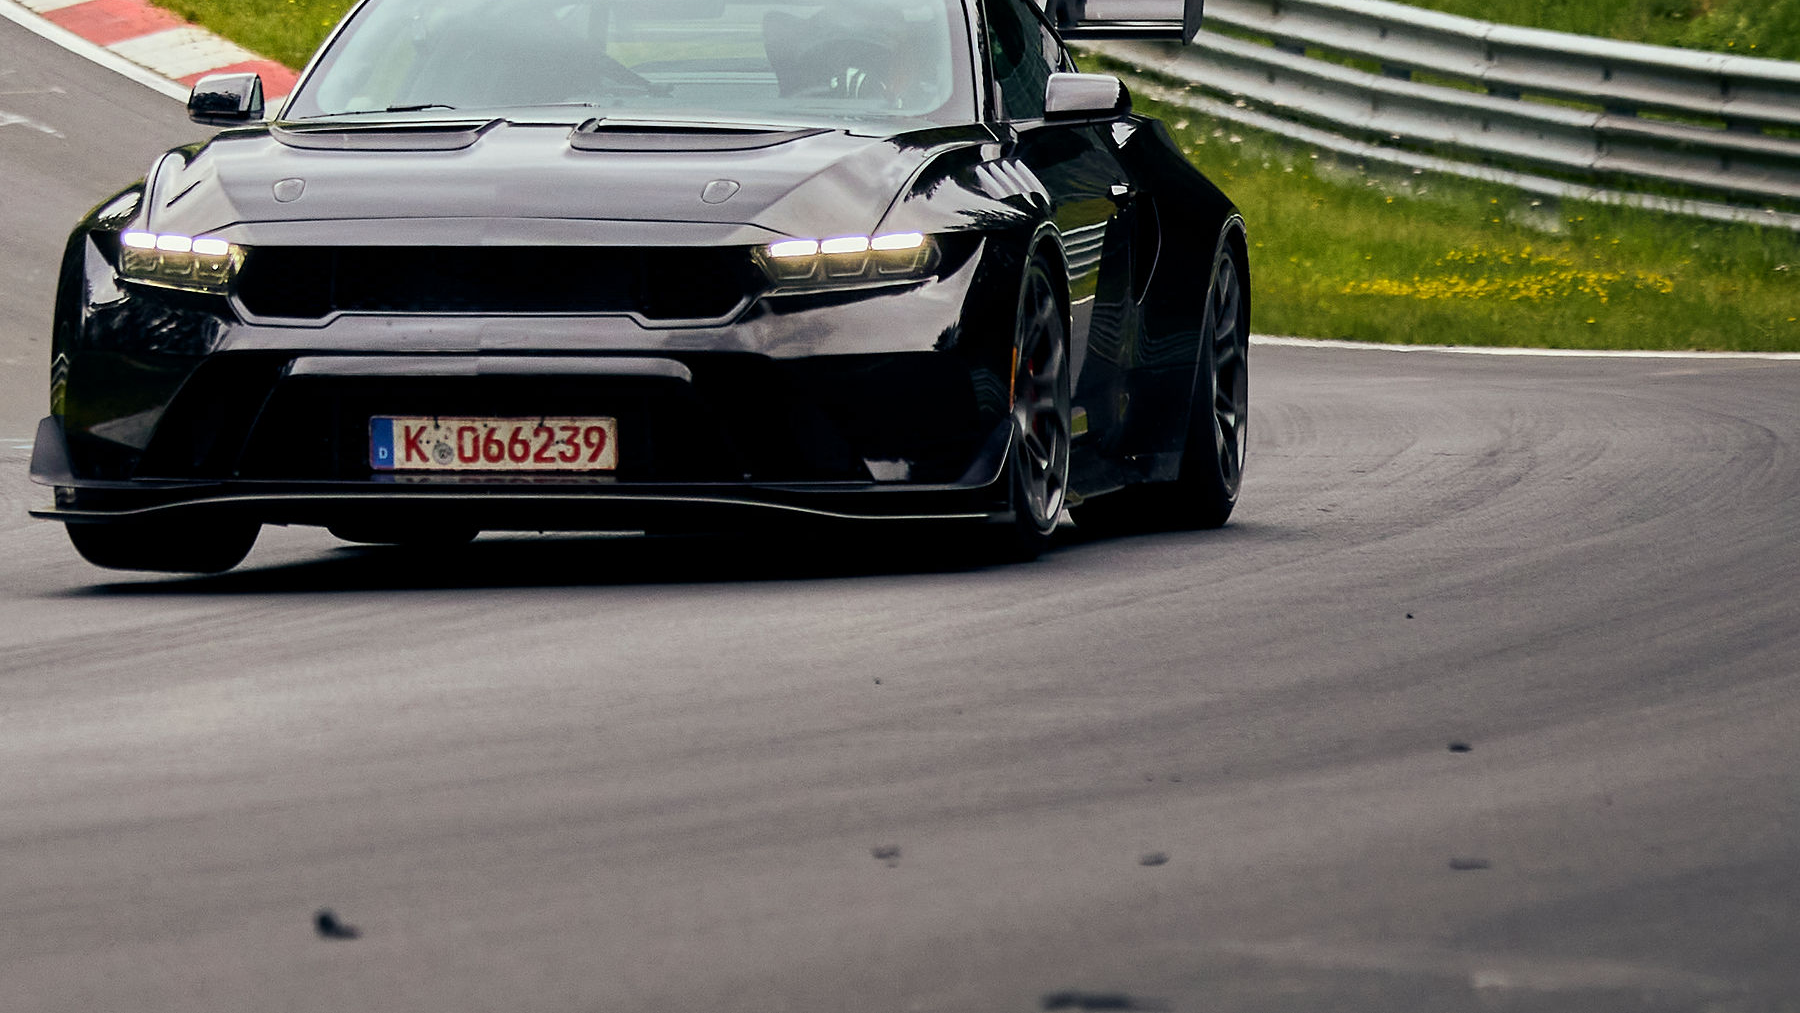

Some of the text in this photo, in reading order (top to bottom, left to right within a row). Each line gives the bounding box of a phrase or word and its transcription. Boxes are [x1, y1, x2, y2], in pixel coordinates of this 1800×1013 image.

[379, 448, 388, 459] D
[403, 424, 607, 464] K 066239
